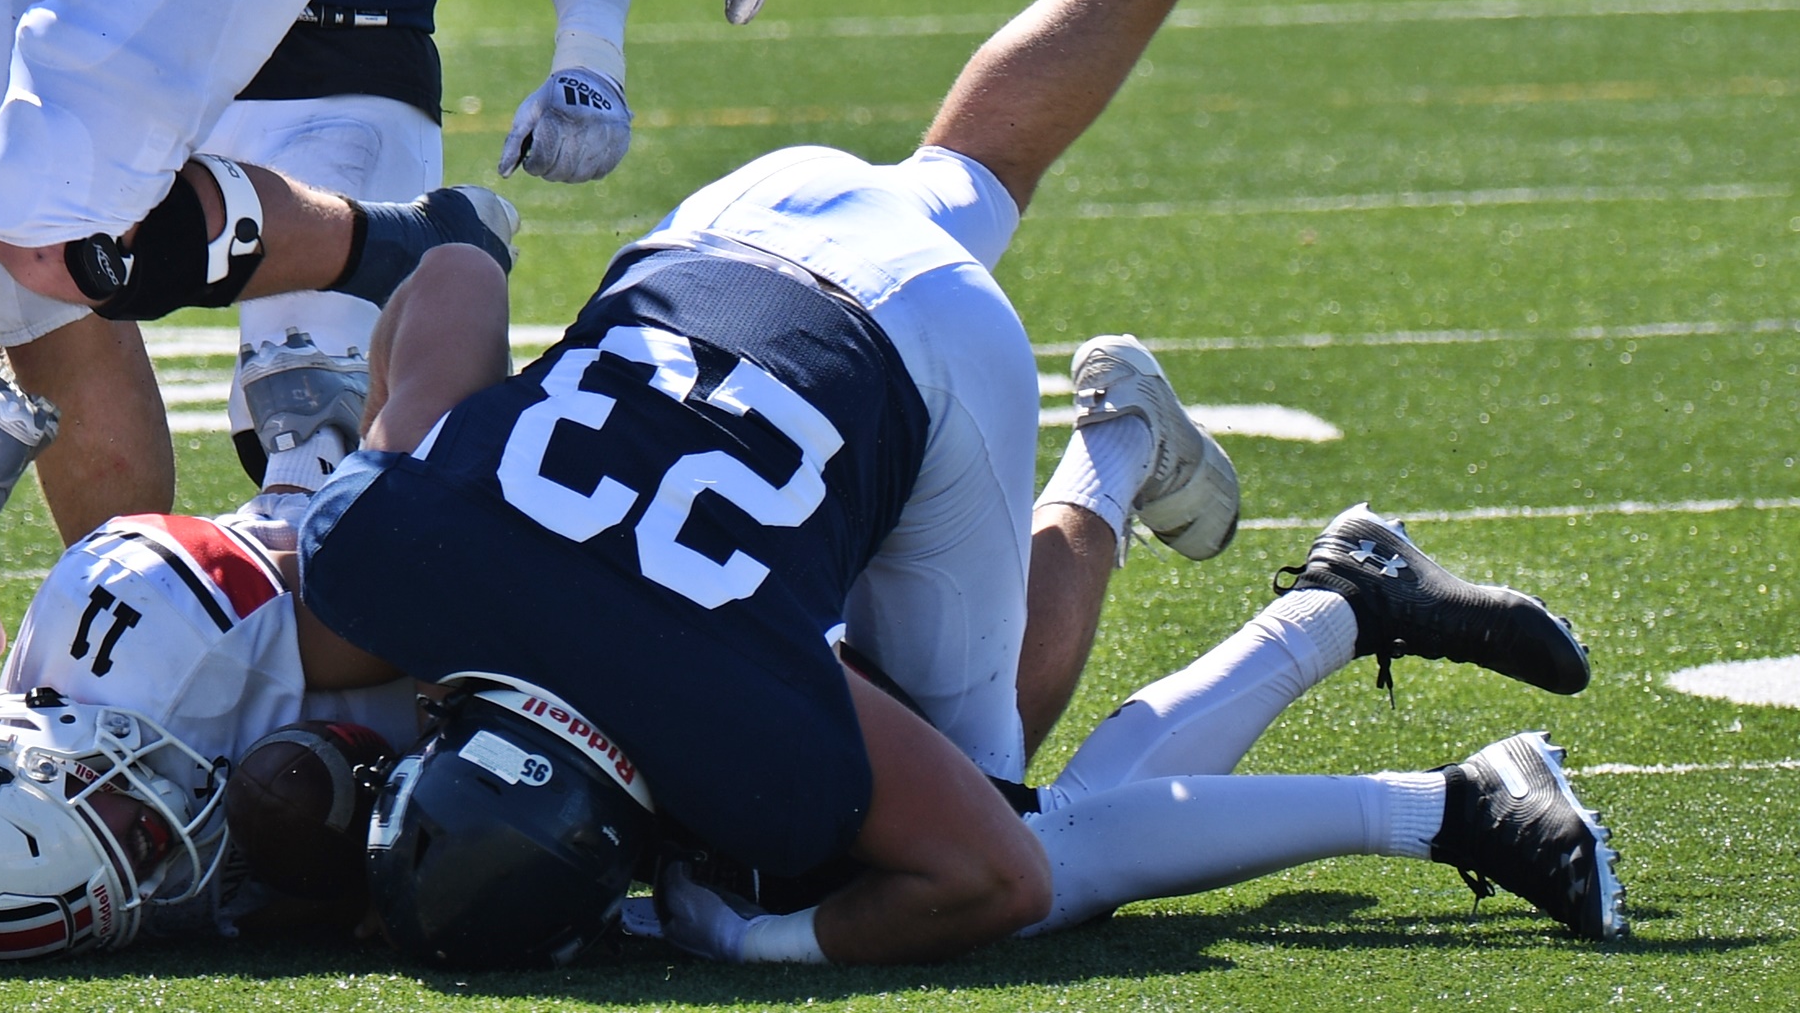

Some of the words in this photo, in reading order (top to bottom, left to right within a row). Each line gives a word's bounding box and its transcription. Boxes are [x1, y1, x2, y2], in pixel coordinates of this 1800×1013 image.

[558, 77, 612, 111] adidas
[497, 325, 846, 610] 23
[68, 584, 143, 678] 11
[520, 757, 550, 783] 95
[521, 697, 636, 786] Riddell
[92, 884, 112, 937] Riddell
